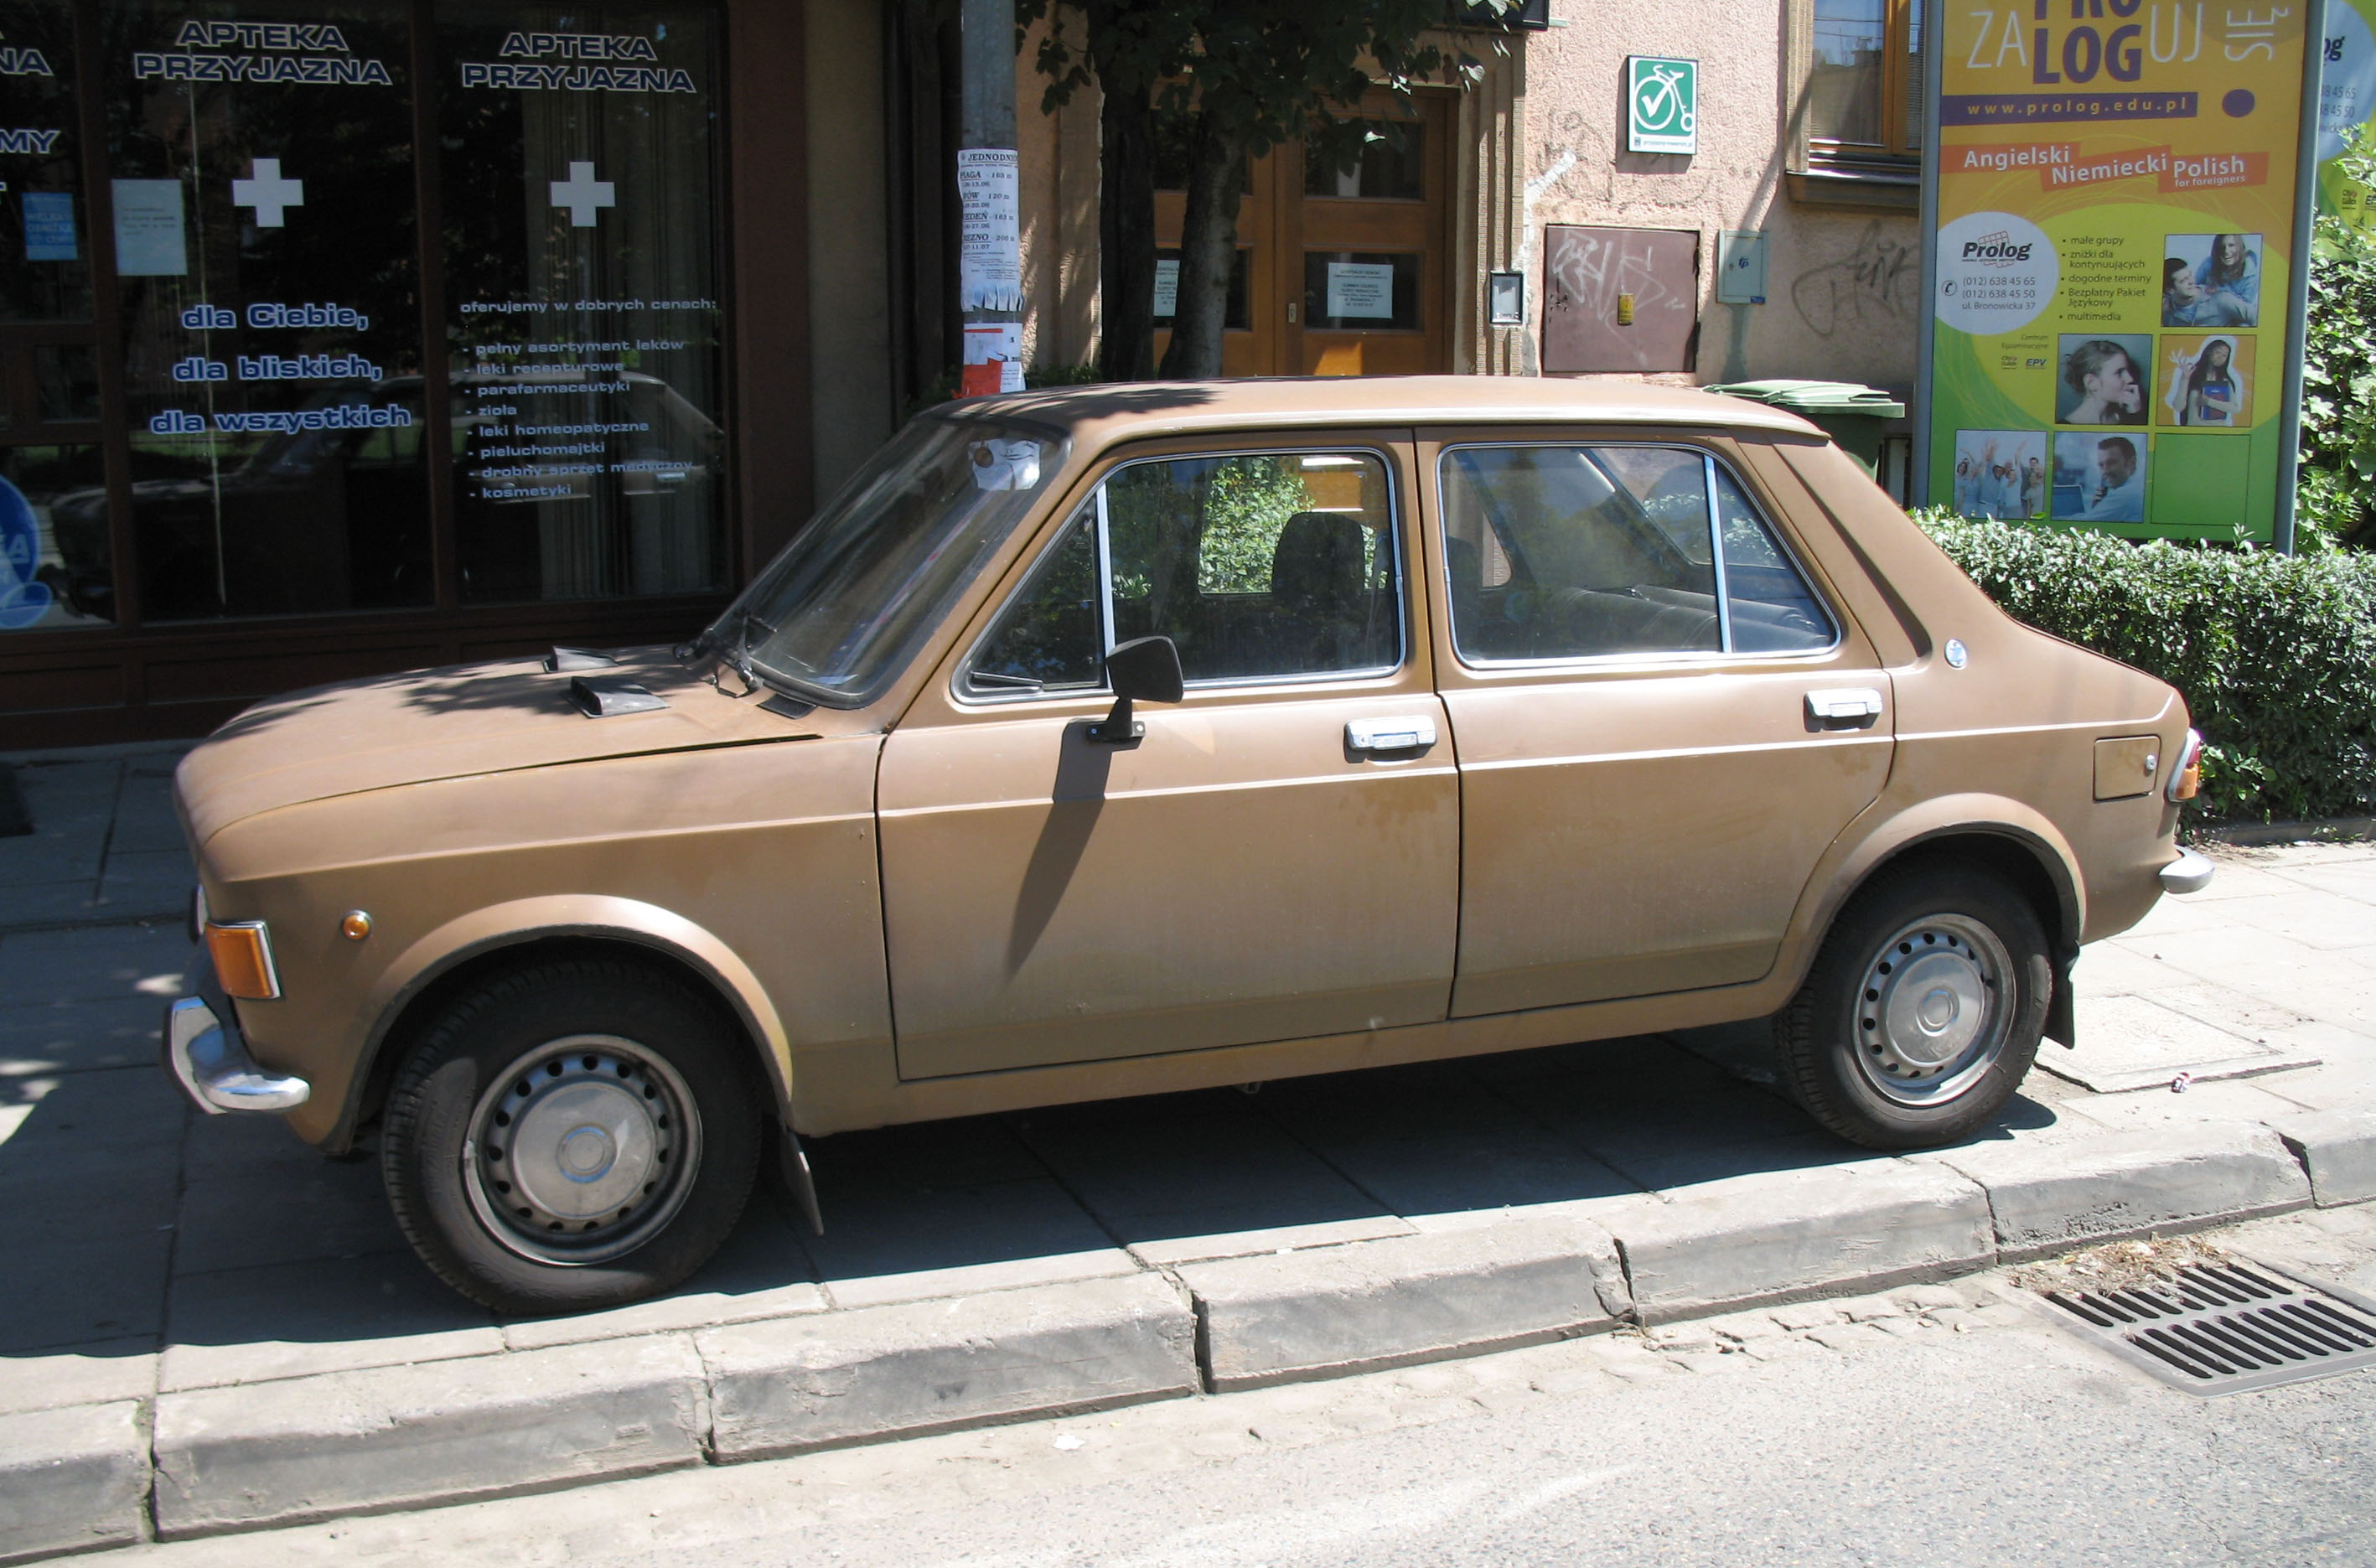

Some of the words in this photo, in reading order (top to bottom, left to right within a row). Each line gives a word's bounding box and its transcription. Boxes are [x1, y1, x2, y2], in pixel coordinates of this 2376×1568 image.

[175, 21, 349, 51] APTEKA
[499, 32, 658, 61] APTEKA
[133, 52, 393, 85] PRZYJAZNA
[462, 63, 697, 94] PRZYJAZNA
[1967, 96, 2187, 116] www.prolog.edu.pl
[1964, 145, 2070, 172] Angielski
[2052, 153, 2167, 185] Niemiecki
[2173, 154, 2245, 179] Polish
[2174, 178, 2190, 188] for
[2192, 174, 2246, 187] foreigners
[2071, 236, 2094, 245] małe
[2096, 237, 2124, 246] grupy
[1962, 241, 2032, 261] Prolog
[2099, 250, 2114, 258] dla
[1963, 277, 1986, 287] (012)
[1989, 277, 2007, 286] 638
[2010, 277, 2021, 286] 45
[2023, 277, 2036, 286] 65
[2068, 275, 2112, 284] dogodne
[1963, 289, 1986, 299] (012)
[1989, 289, 2006, 298] 638
[2009, 289, 2021, 298] 45
[2023, 289, 2036, 298] 50
[460, 301, 547, 314] oferujemy
[554, 303, 568, 311] w
[575, 298, 644, 313] dobrych
[651, 298, 717, 309] cenach:
[181, 304, 237, 329] dla
[246, 303, 369, 331] Ciebie,
[475, 342, 522, 356] pełny
[528, 340, 629, 354] asortyment
[636, 339, 684, 350] leków
[173, 357, 228, 381] dla
[238, 354, 382, 381] bliskich,
[477, 363, 505, 375] leki
[513, 362, 624, 375] recepturowe
[478, 380, 630, 397] parafarmaceutyki
[151, 409, 205, 434] dla
[215, 403, 412, 434] wszystkich
[478, 404, 517, 417] zioła
[479, 425, 509, 437] leki
[515, 422, 650, 435] homeopatyczne
[480, 442, 605, 459] pieluchomajtki
[482, 466, 542, 479] drobny
[549, 463, 604, 476] sprzęt
[610, 461, 693, 473] medyczny
[482, 484, 571, 499] kosmetyki
